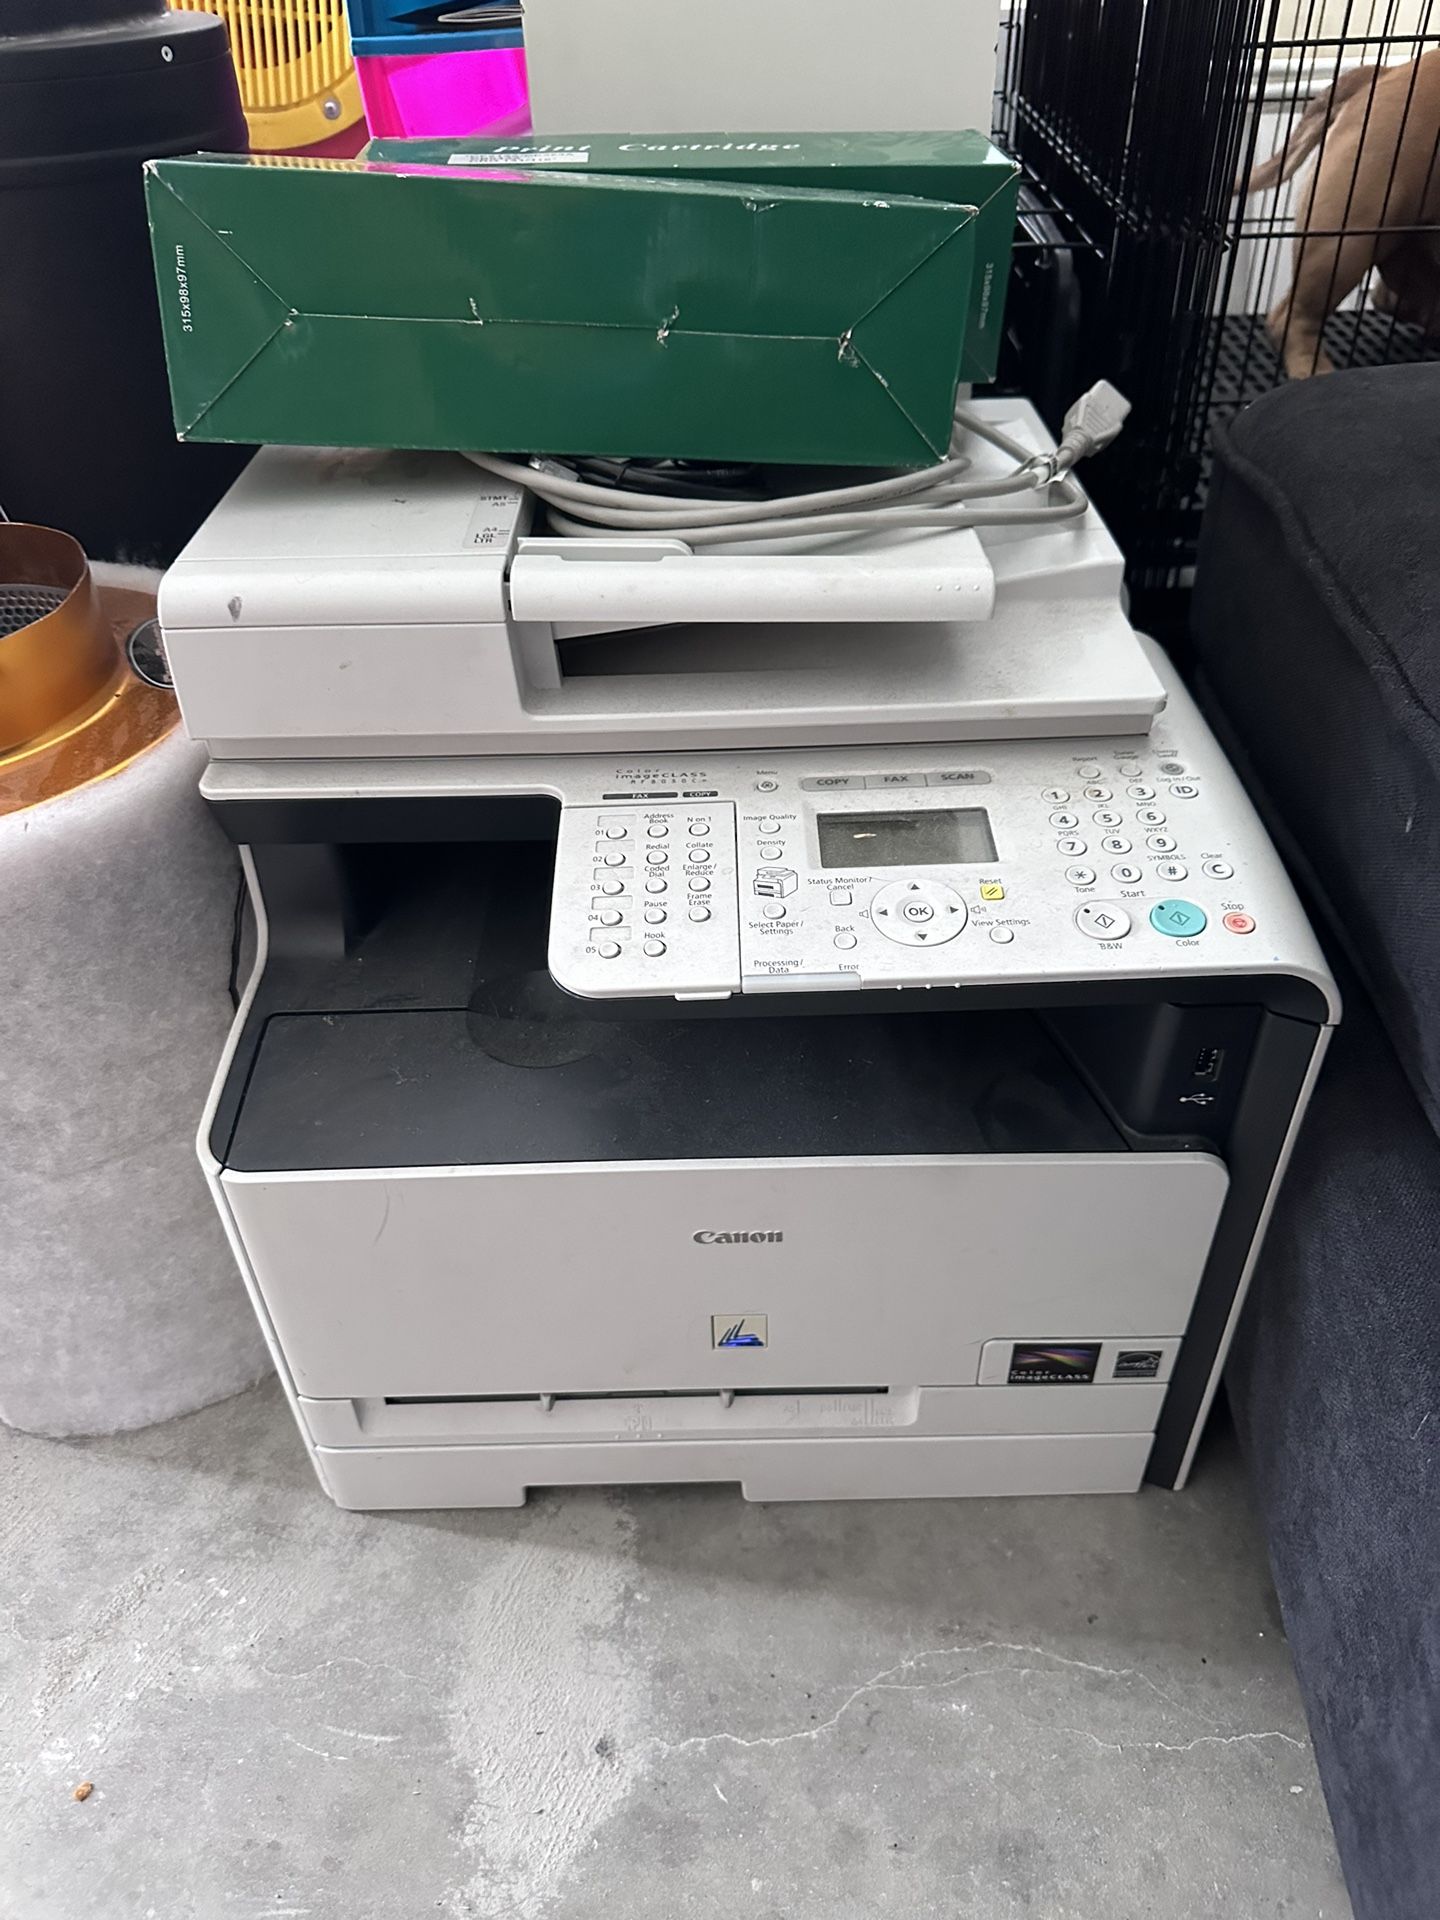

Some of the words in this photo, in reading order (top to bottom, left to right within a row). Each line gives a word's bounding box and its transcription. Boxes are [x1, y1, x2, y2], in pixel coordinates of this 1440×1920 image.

[493, 144, 591, 153] Print
[618, 142, 801, 151] Cartridge
[175, 244, 193, 333] 315x98x97mm
[615, 772, 707, 780] imageCLASS
[883, 774, 909, 783] FAX
[940, 773, 975, 782] SCAN
[816, 778, 850, 787] COPY
[1093, 789, 1104, 798] 2
[1136, 787, 1146, 796] 3
[1176, 786, 1193, 794] ID
[743, 814, 768, 822] Image
[768, 812, 798, 822] Quality
[1059, 816, 1069, 825] 4
[1102, 814, 1112, 823] 5
[1146, 812, 1157, 821] 6
[756, 838, 786, 848] Density
[1066, 842, 1076, 851] 7
[1112, 840, 1122, 849] 8
[1156, 838, 1166, 847] 9
[1121, 868, 1132, 878] 0
[1212, 864, 1225, 874] C
[808, 877, 834, 885] Status
[826, 882, 854, 890] Cancel
[1120, 890, 1146, 898] Start
[908, 906, 929, 917] OK
[1220, 902, 1245, 912] Stop
[748, 921, 775, 929] Select
[971, 919, 994, 927] View
[996, 918, 1031, 928] Settings
[760, 928, 794, 936] Settings
[1176, 940, 1200, 948] Color
[768, 966, 790, 974] Data
[693, 1230, 784, 1245] Canon
